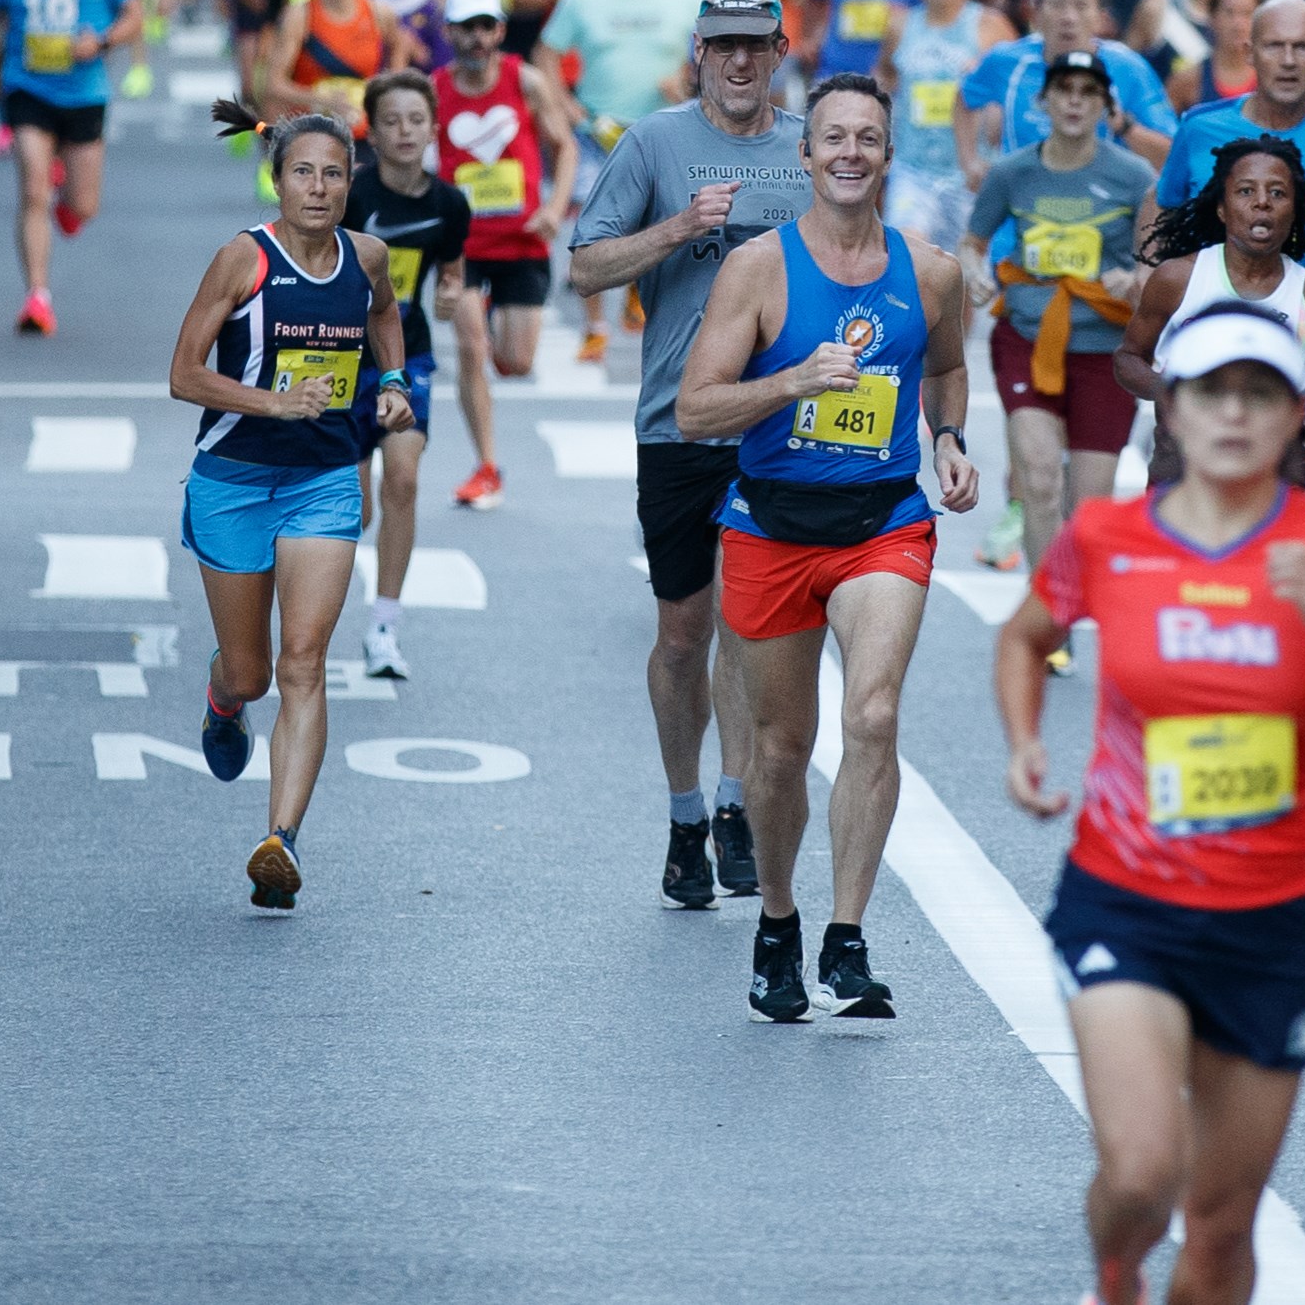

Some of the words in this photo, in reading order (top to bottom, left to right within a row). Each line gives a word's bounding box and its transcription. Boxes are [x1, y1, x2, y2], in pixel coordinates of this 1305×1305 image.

[688, 165, 804, 181] SHAWANGUNK
[756, 181, 783, 190] TRAIL
[785, 182, 805, 191] RUN
[763, 209, 795, 220] 2021
[274, 322, 315, 337] FRONT
[318, 323, 365, 339] RUNNERS
[834, 408, 876, 434] 481
